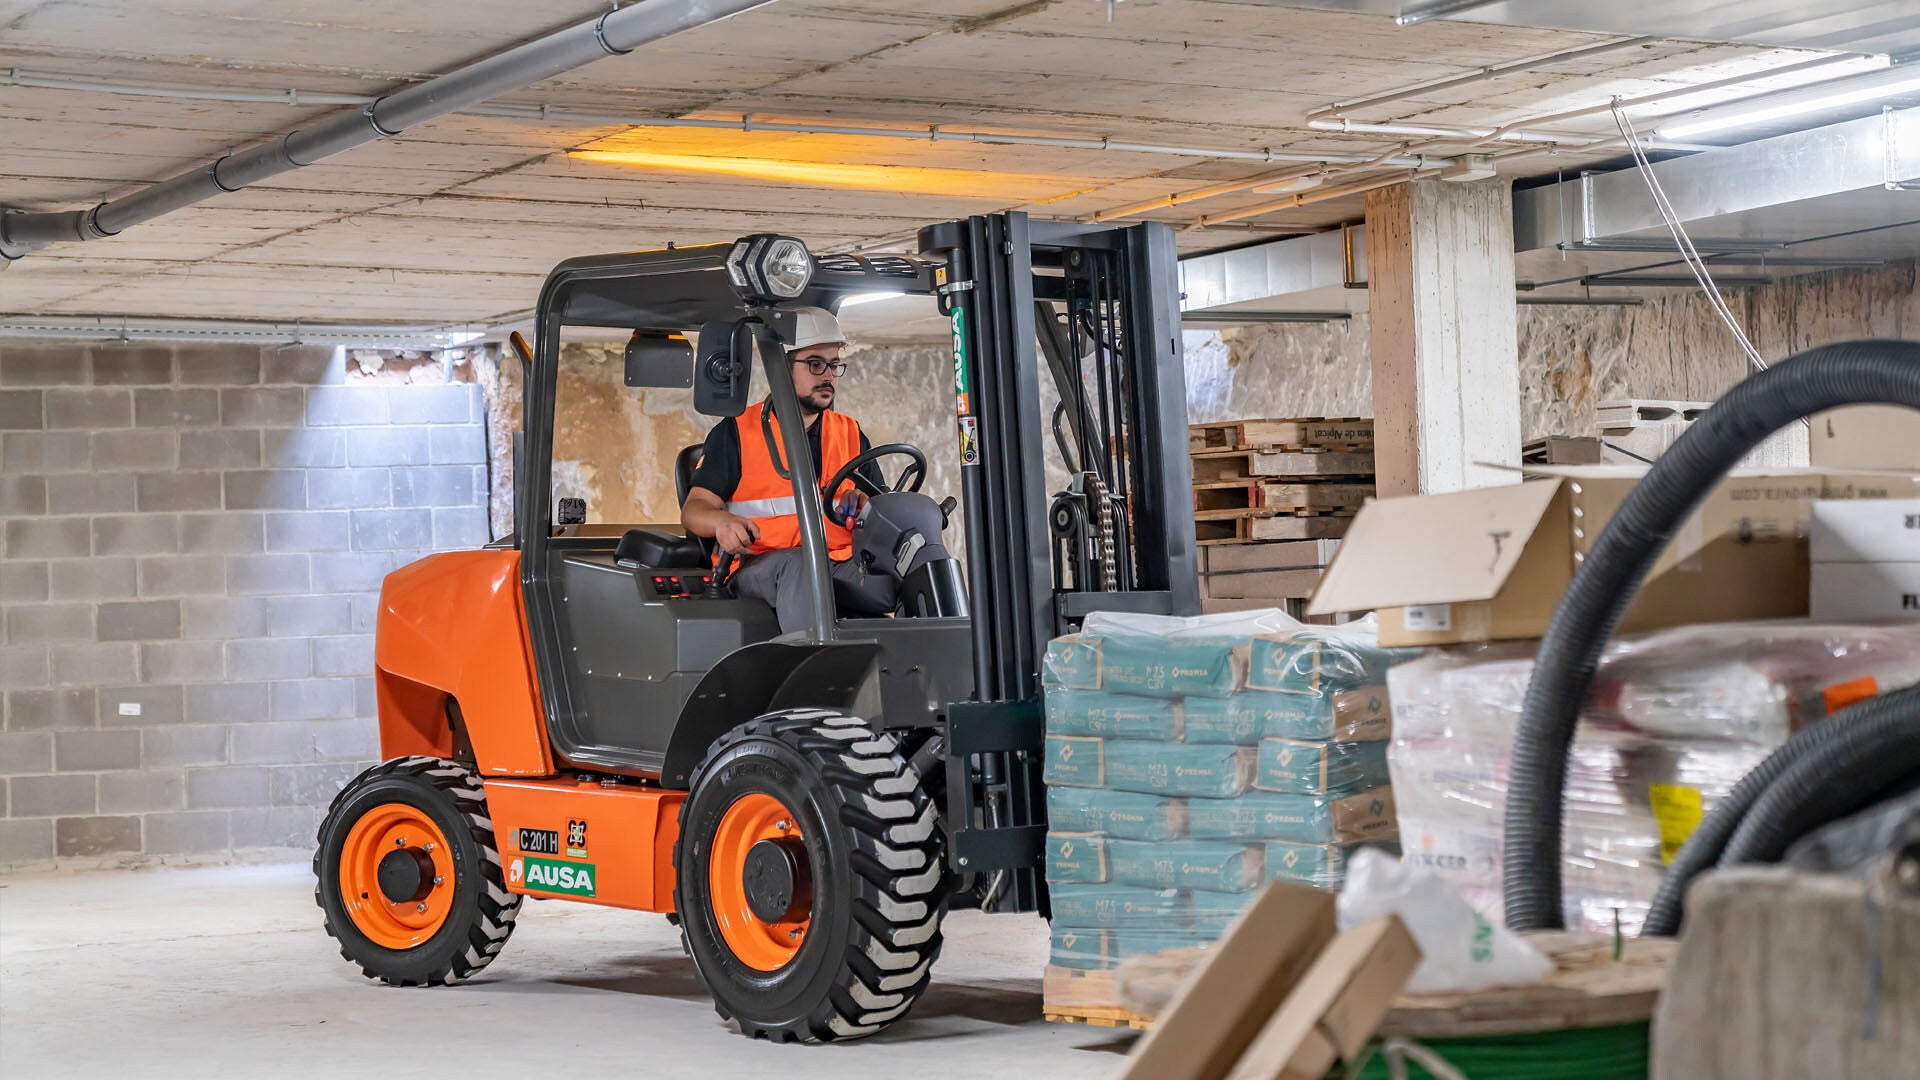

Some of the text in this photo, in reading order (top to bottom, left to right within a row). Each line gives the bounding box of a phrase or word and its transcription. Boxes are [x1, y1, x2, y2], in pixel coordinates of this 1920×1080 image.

[952, 312, 963, 391] AUSA
[1344, 430, 1354, 439] de
[520, 830, 528, 849] C
[530, 831, 547, 851] 201
[550, 833, 558, 853] H
[527, 864, 593, 891] AUSA
